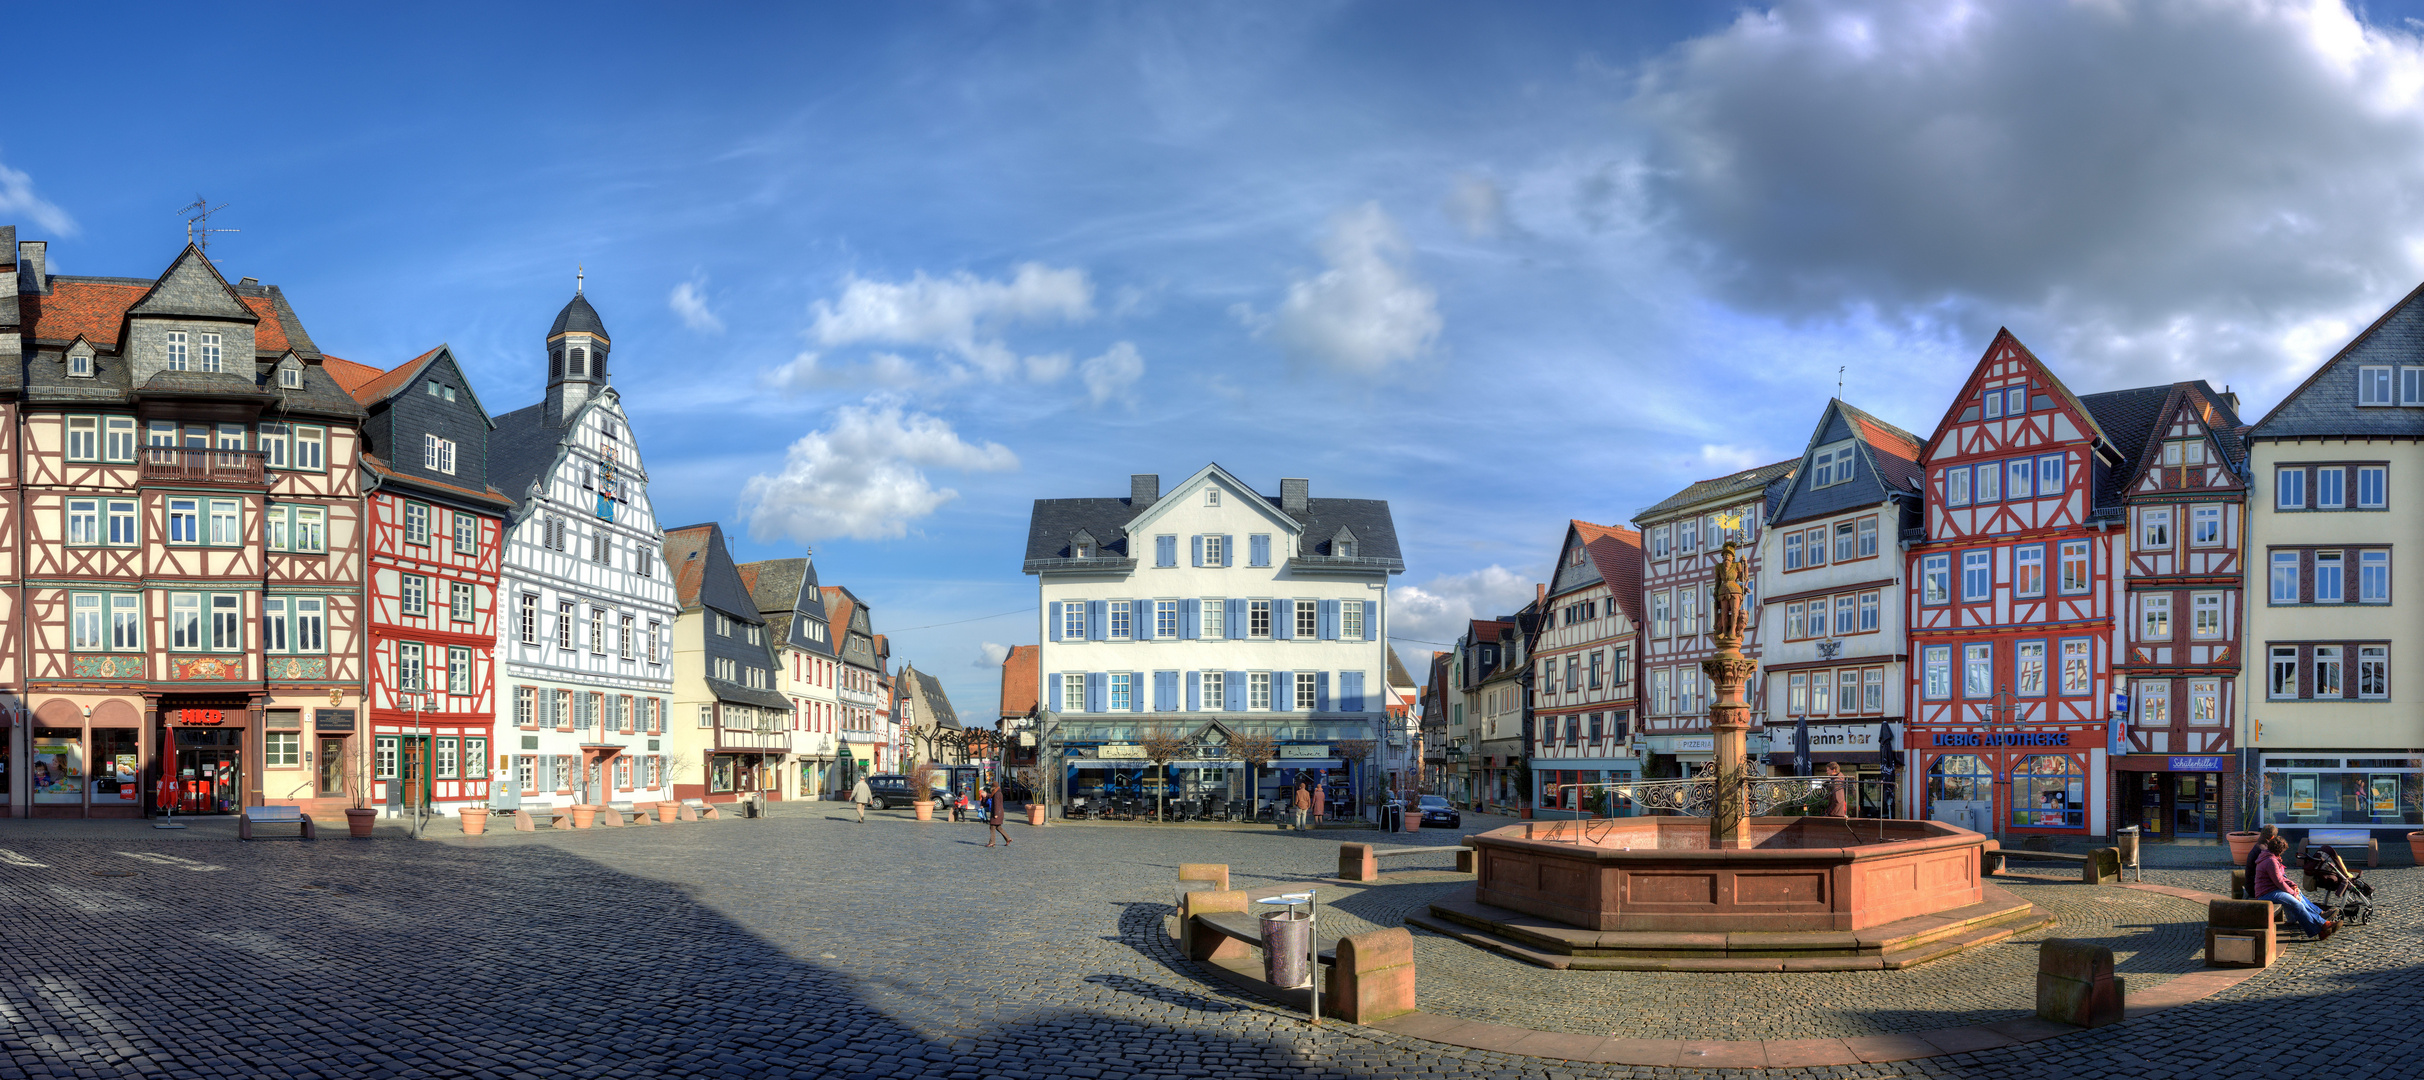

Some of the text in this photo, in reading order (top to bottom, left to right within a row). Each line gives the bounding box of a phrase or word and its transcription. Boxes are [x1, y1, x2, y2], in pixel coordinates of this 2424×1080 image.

[181, 708, 222, 723] NKD
[1683, 740, 1712, 748] PIZZERIA
[1848, 733, 1871, 744] bar
[1932, 732, 2069, 746] LIEBIG APOTHEKE
